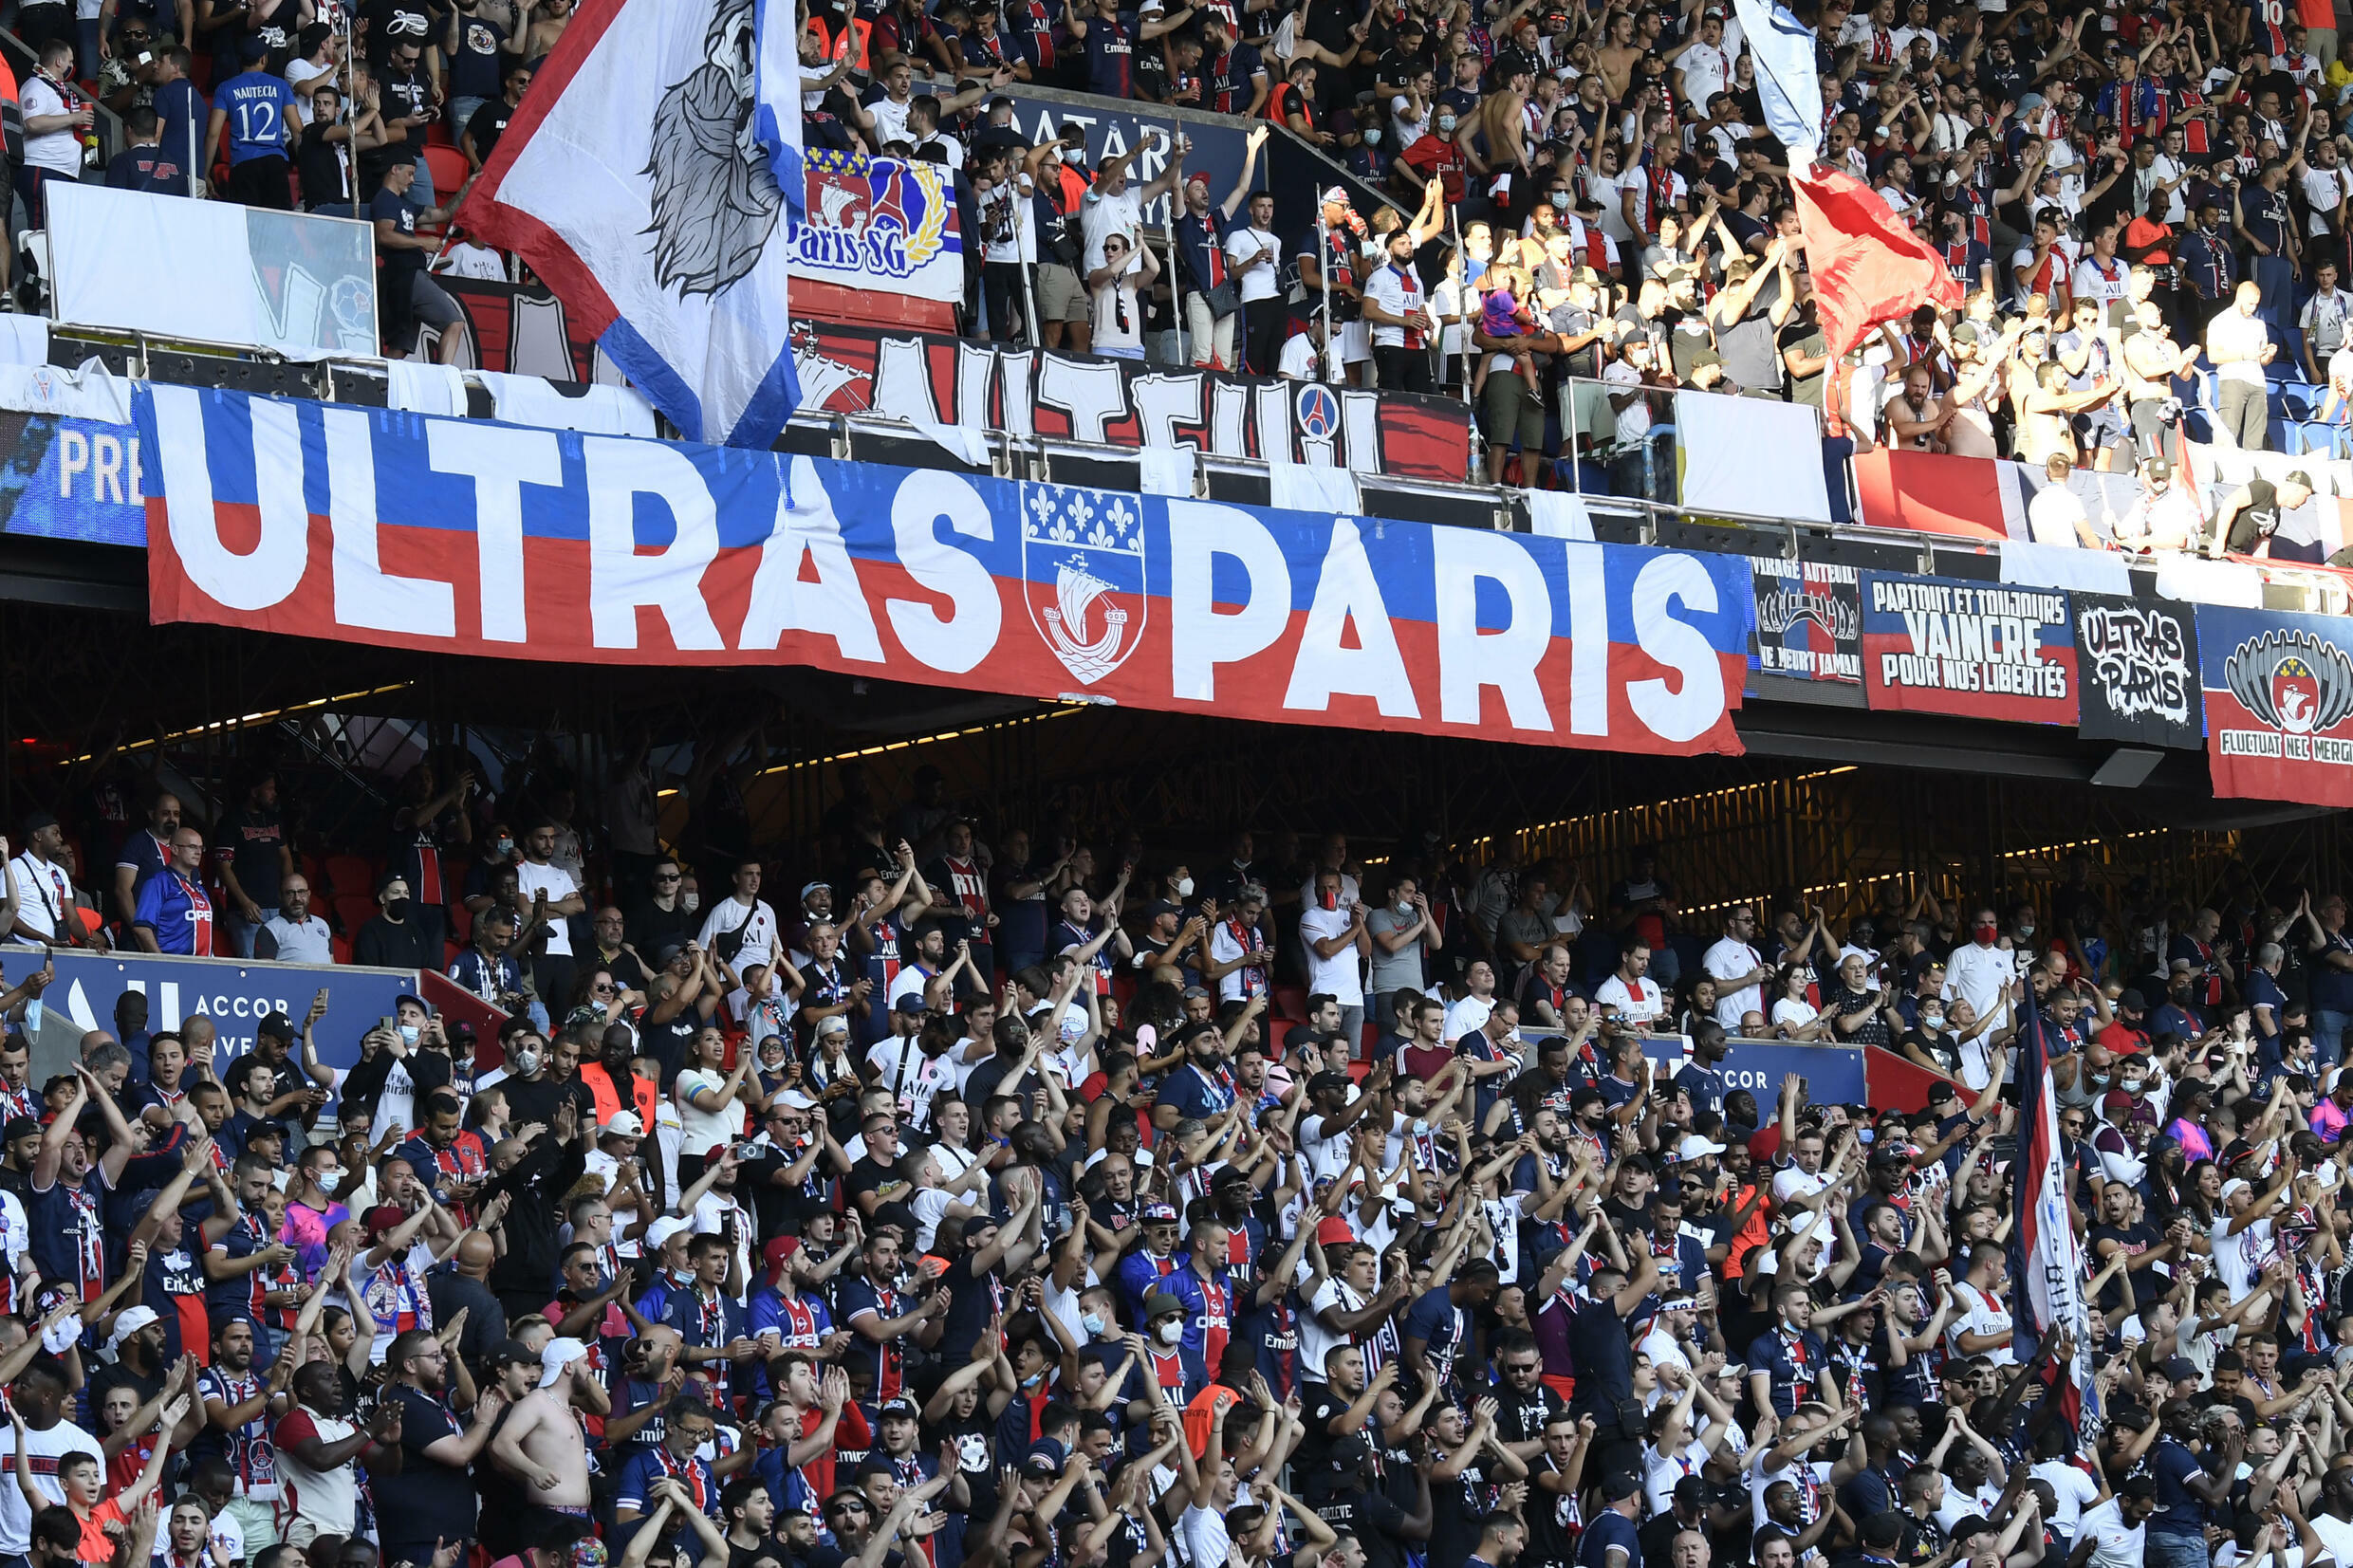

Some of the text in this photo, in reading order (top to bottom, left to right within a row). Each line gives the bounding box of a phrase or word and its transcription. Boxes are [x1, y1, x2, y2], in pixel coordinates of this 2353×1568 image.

[2262, 0, 2283, 25] 10
[233, 85, 277, 100] NAUTECIA
[237, 101, 277, 142] 12
[149, 383, 1003, 674] ULTRAS
[1751, 556, 1857, 584] VIRAGE AUTEUIL
[1872, 581, 2066, 624] PARTOUT ET TOUJOURS
[1167, 497, 1727, 743] PARIS
[1902, 608, 2043, 668] VAINCRE
[2086, 611, 2182, 661] ULTRAS
[1778, 646, 1816, 672] MEURT
[1818, 653, 1861, 676] JAMAI
[1881, 654, 2067, 698] POUR NOS LIBERTÉS
[2099, 660, 2184, 710] PARIS
[2221, 731, 2280, 755] FLUCTUAT
[2286, 736, 2308, 758] NEC
[184, 910, 213, 922] OPE
[213, 1037, 252, 1057] IVE
[1713, 1069, 1768, 1089] COR
[782, 1333, 820, 1348] OPEL
